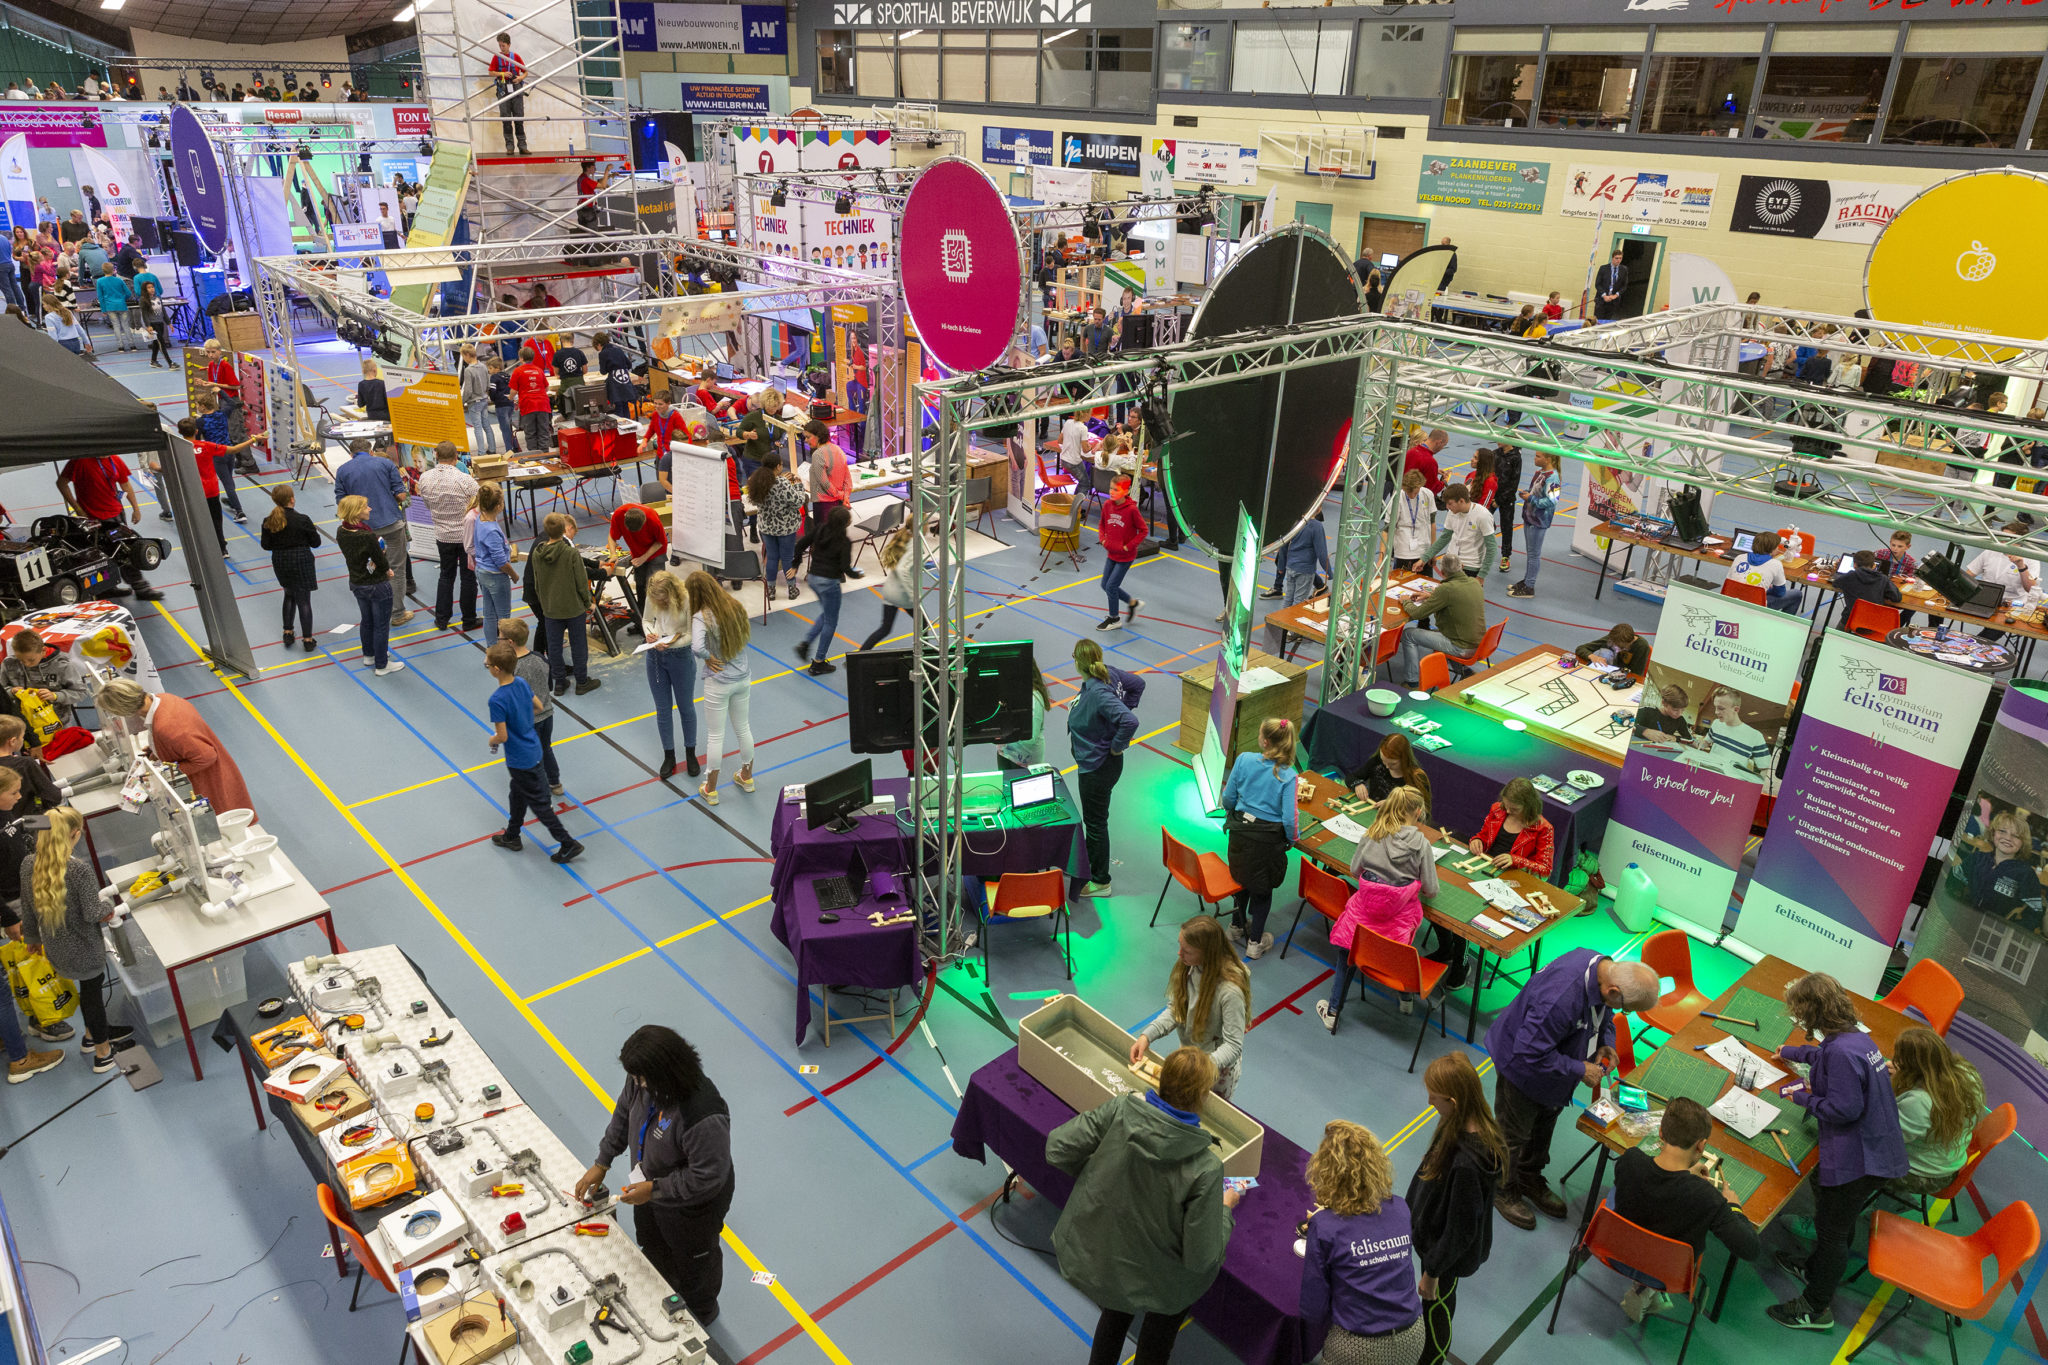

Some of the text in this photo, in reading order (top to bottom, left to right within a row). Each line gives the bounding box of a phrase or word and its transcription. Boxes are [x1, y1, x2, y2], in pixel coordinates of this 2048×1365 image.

[877, 0, 1033, 24] SPORTHAL BEVERWIJK
[657, 18, 739, 31] Nieuwbouwwoning
[750, 21, 776, 38] AM
[660, 41, 740, 51] www.AMWONEN.nl
[267, 110, 299, 120] Hesani
[397, 113, 419, 122] TON
[1086, 144, 1137, 162] HUIPEN
[761, 154, 770, 173] 7
[1202, 162, 1212, 170] 3M
[1450, 158, 1517, 172] ZAANBEVER
[1450, 172, 1513, 183] PLANKENVLOEREN
[637, 203, 663, 215] Metaal
[760, 199, 776, 216] VAN
[1419, 193, 1444, 202] VELSEN
[1445, 196, 1471, 205] NOORD
[1494, 200, 1541, 211] 0251-227512
[1768, 197, 1789, 205] EYE
[1562, 209, 1588, 217] Kingsford
[1664, 217, 1707, 227] 0251-249149
[1838, 204, 1896, 221] RACIN
[755, 216, 788, 235] ECHNIEK
[825, 218, 875, 236] TECHNIEK
[1835, 221, 1865, 229] BEVERWIJK
[941, 322, 958, 331] Hi-tech
[963, 325, 982, 334] Science
[1922, 319, 1955, 330] Voeding
[1964, 325, 1993, 334] Natuur
[24, 557, 45, 583] 11
[1717, 623, 1732, 635] 70
[1685, 633, 1768, 673] felisenum
[1716, 638, 1770, 660] gymnasium
[1719, 661, 1765, 683] Velsen-Zuid
[1881, 677, 1899, 691] 70
[1843, 687, 1939, 733] felisenum
[1880, 693, 1943, 719] gymnasium
[1881, 718, 1935, 744] Velsen-Zuid
[1820, 748, 1910, 789] Kleinschalig en veilig
[1641, 766, 1735, 808] De school voor jou!
[1815, 766, 1881, 797] Enthousiaste en
[1812, 776, 1895, 814] toegewijde docenten
[1803, 802, 1868, 834] technisch talent
[1806, 793, 1901, 837] Ruimte voor creatief en
[1795, 829, 1851, 856] eersteklassers
[1798, 819, 1906, 871] Uitgebreide ondersteuning
[1631, 839, 1702, 877] felisenum.nl
[1775, 904, 1853, 950] felisenum.nl
[1350, 1234, 1411, 1257] felisenum
[1359, 1259, 1368, 1267] de
[1369, 1253, 1389, 1265] school
[1389, 1252, 1401, 1260] voor
